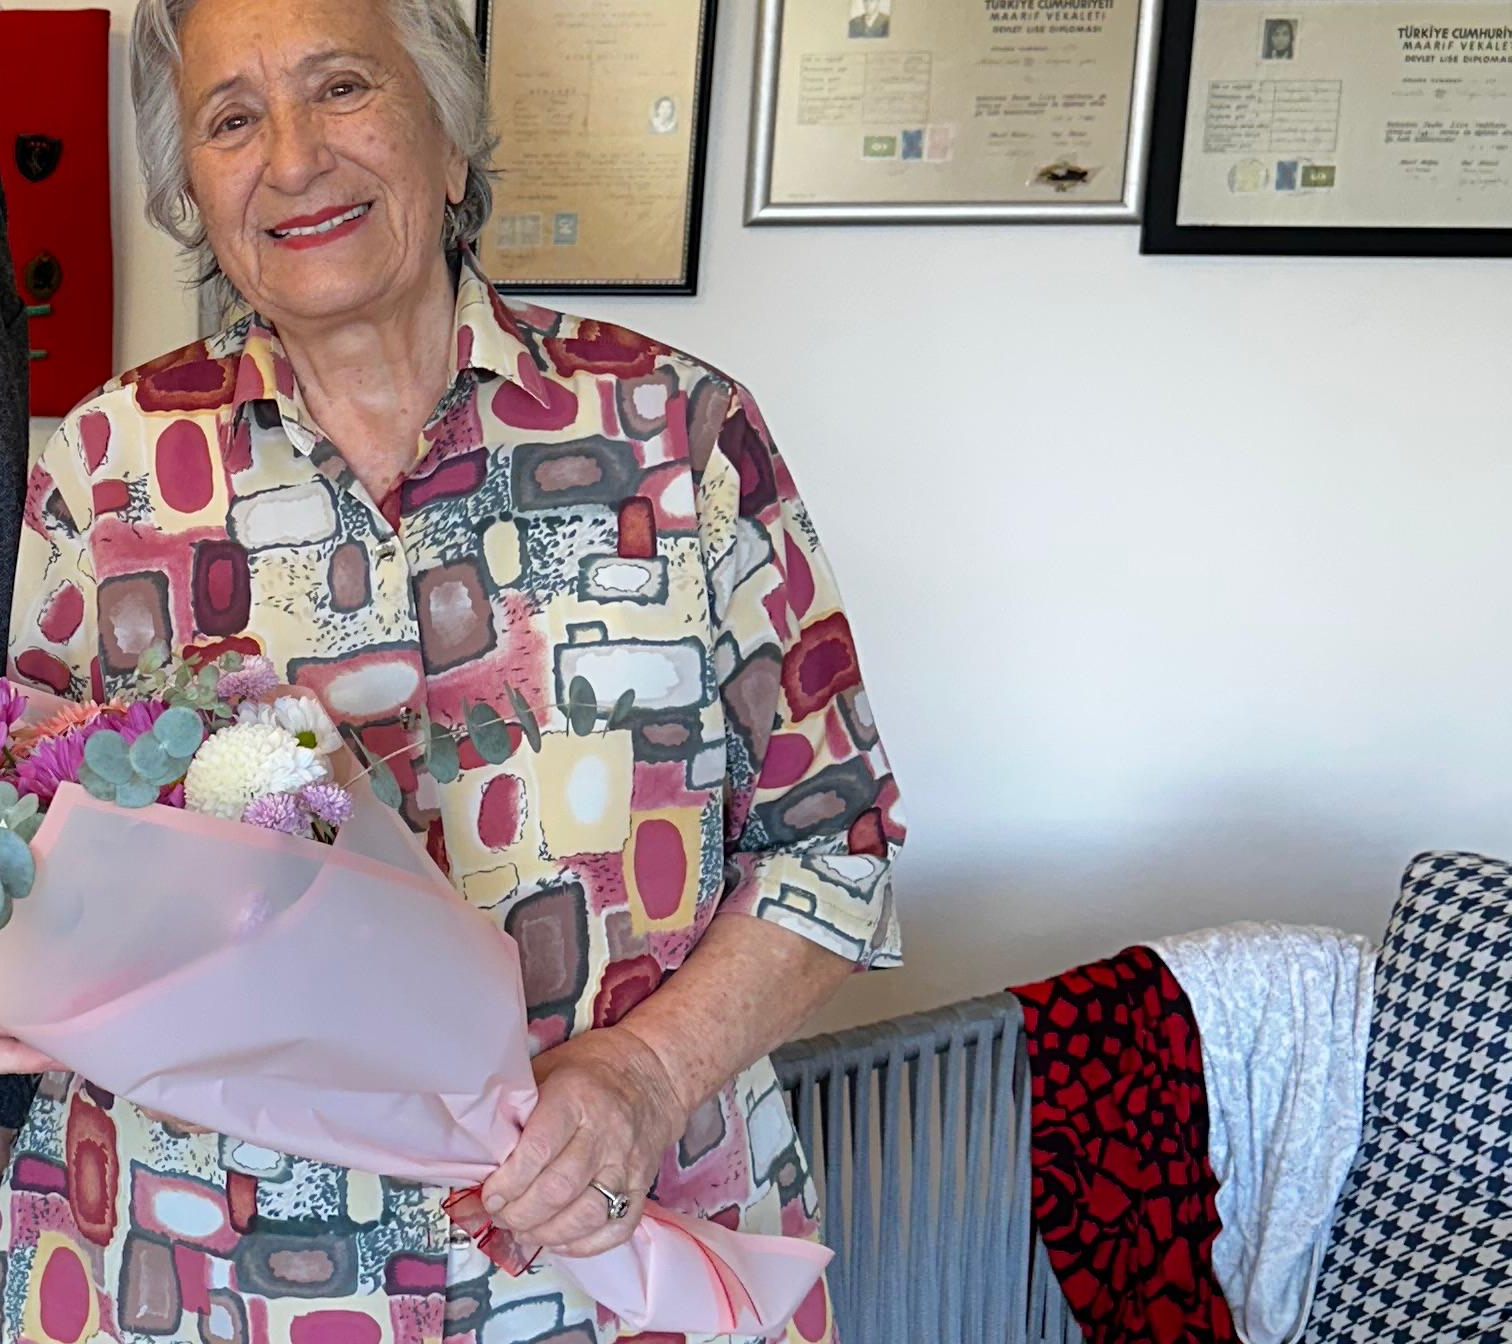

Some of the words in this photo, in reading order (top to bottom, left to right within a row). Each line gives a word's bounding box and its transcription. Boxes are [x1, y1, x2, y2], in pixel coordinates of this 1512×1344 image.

[1397, 25, 1449, 39] TÜRKİYE
[1460, 41, 1512, 51] VEKALE
[1404, 55, 1436, 63] DEVLET
